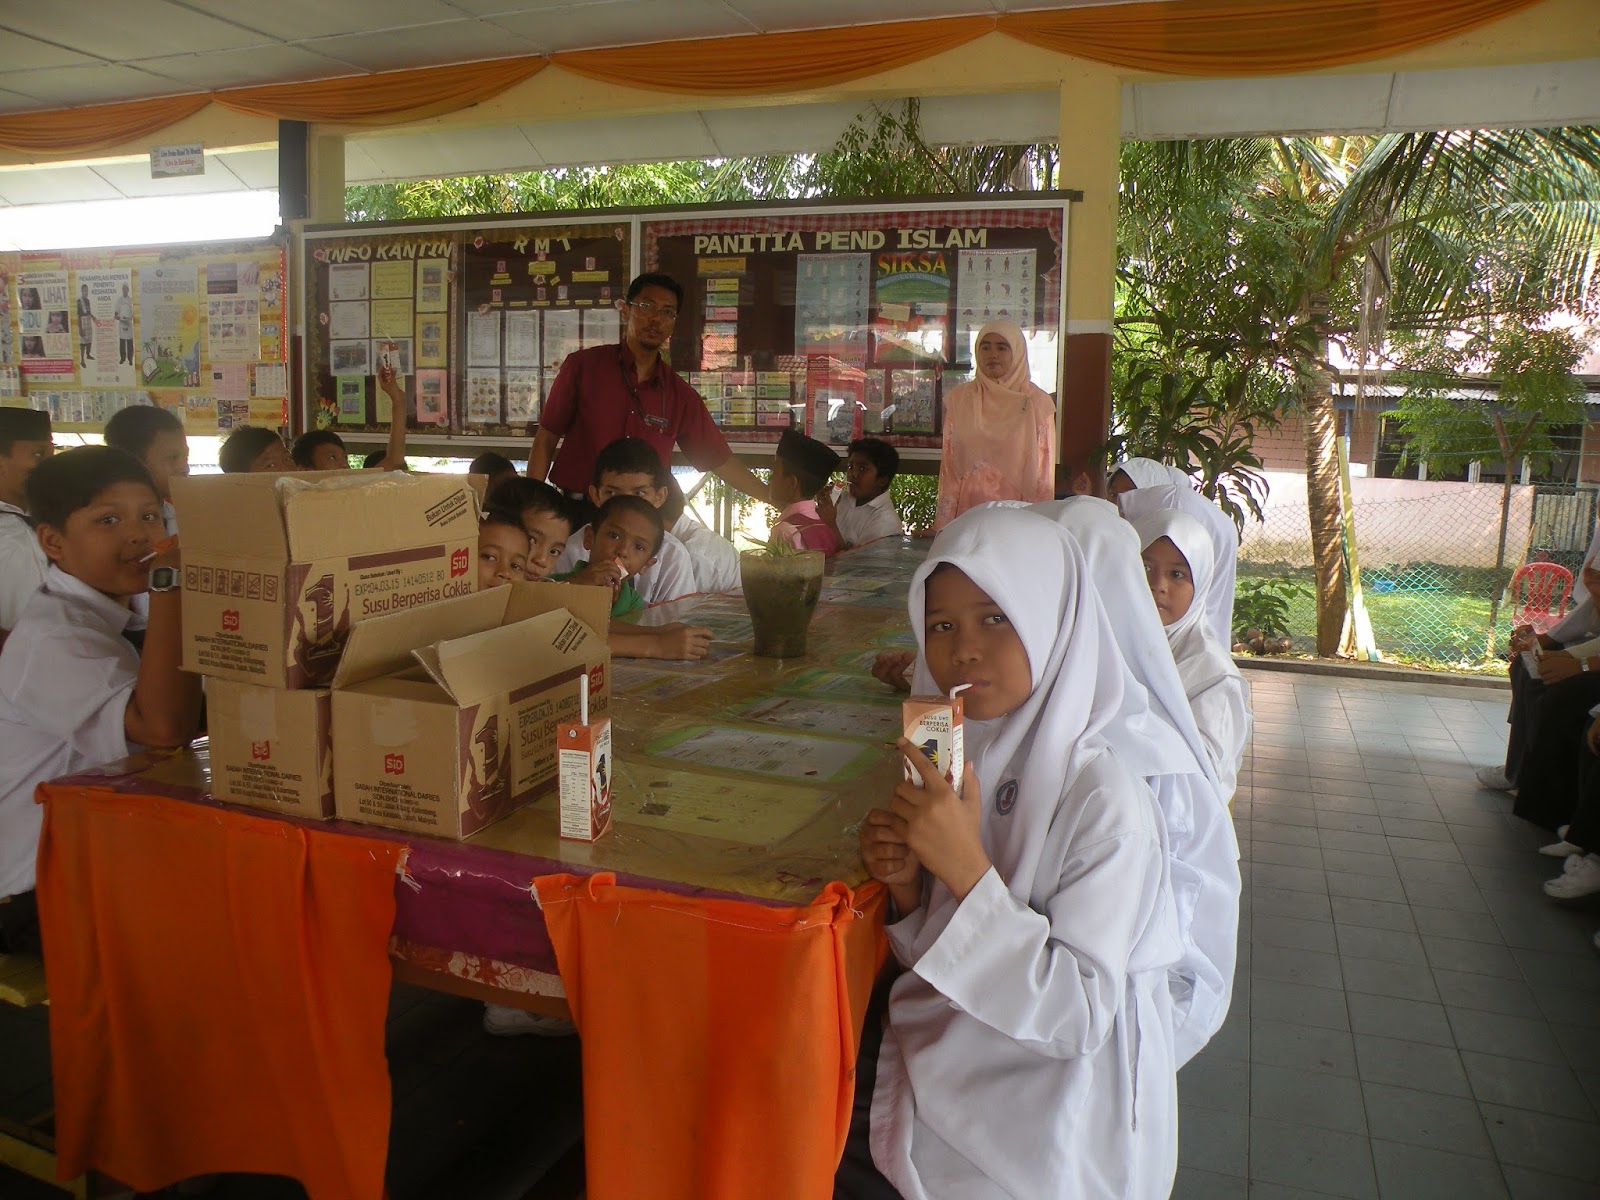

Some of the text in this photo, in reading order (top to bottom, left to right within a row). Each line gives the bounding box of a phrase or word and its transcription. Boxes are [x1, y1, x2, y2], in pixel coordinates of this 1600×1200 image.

[321, 241, 453, 263] INFO KANTIN
[694, 228, 988, 254] PANITIA PEND ISLAM
[877, 251, 948, 278] SIKSA
[362, 598, 390, 615] Susu
[392, 586, 440, 609] Berperisa
[443, 580, 472, 599] Coklat
[521, 728, 543, 748] Susu
[588, 695, 608, 717] oklat
[920, 720, 949, 728] BERPERISA
[354, 783, 372, 791] SABAH
[373, 785, 417, 798] INTERNATIONAL
[417, 792, 440, 802] DAIRIES
